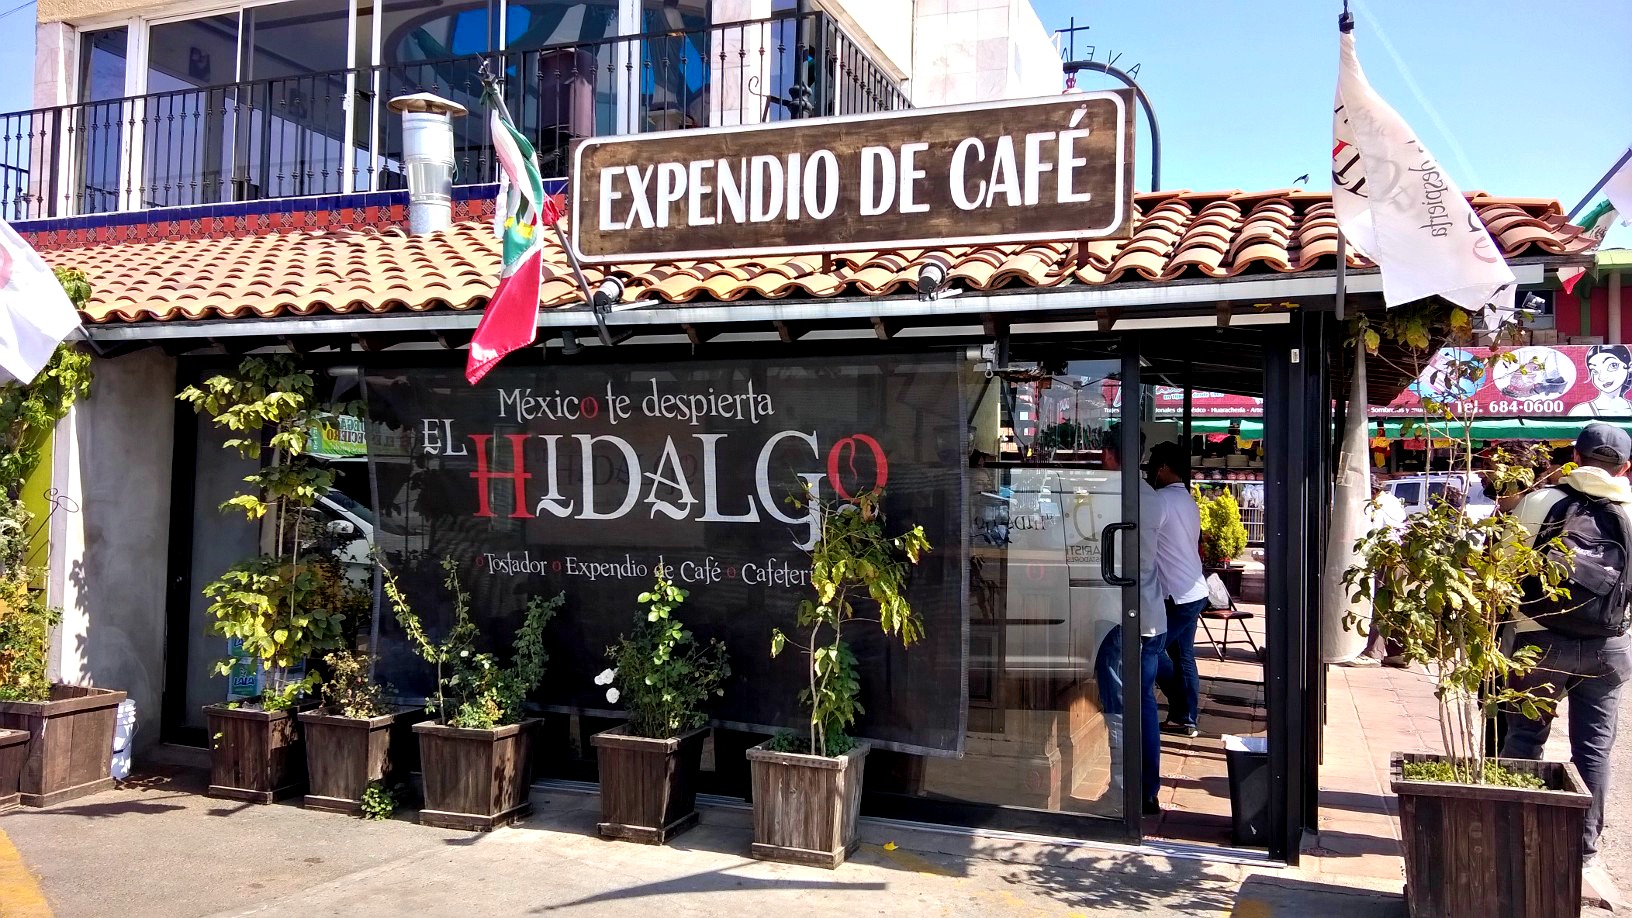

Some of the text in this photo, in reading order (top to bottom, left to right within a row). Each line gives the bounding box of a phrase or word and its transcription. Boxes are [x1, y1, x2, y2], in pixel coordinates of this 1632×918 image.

[599, 104, 1092, 231] EXPENDIO DE CAFÉ
[497, 378, 776, 426] México te despierta
[1455, 400, 1484, 413] Tel.
[421, 418, 468, 456] EL
[467, 430, 889, 552] HIDALGO
[483, 551, 548, 576] Tostador
[565, 553, 648, 581] Expendio
[654, 554, 675, 579] de
[680, 556, 722, 585] Café
[233, 676, 255, 687] LALA
